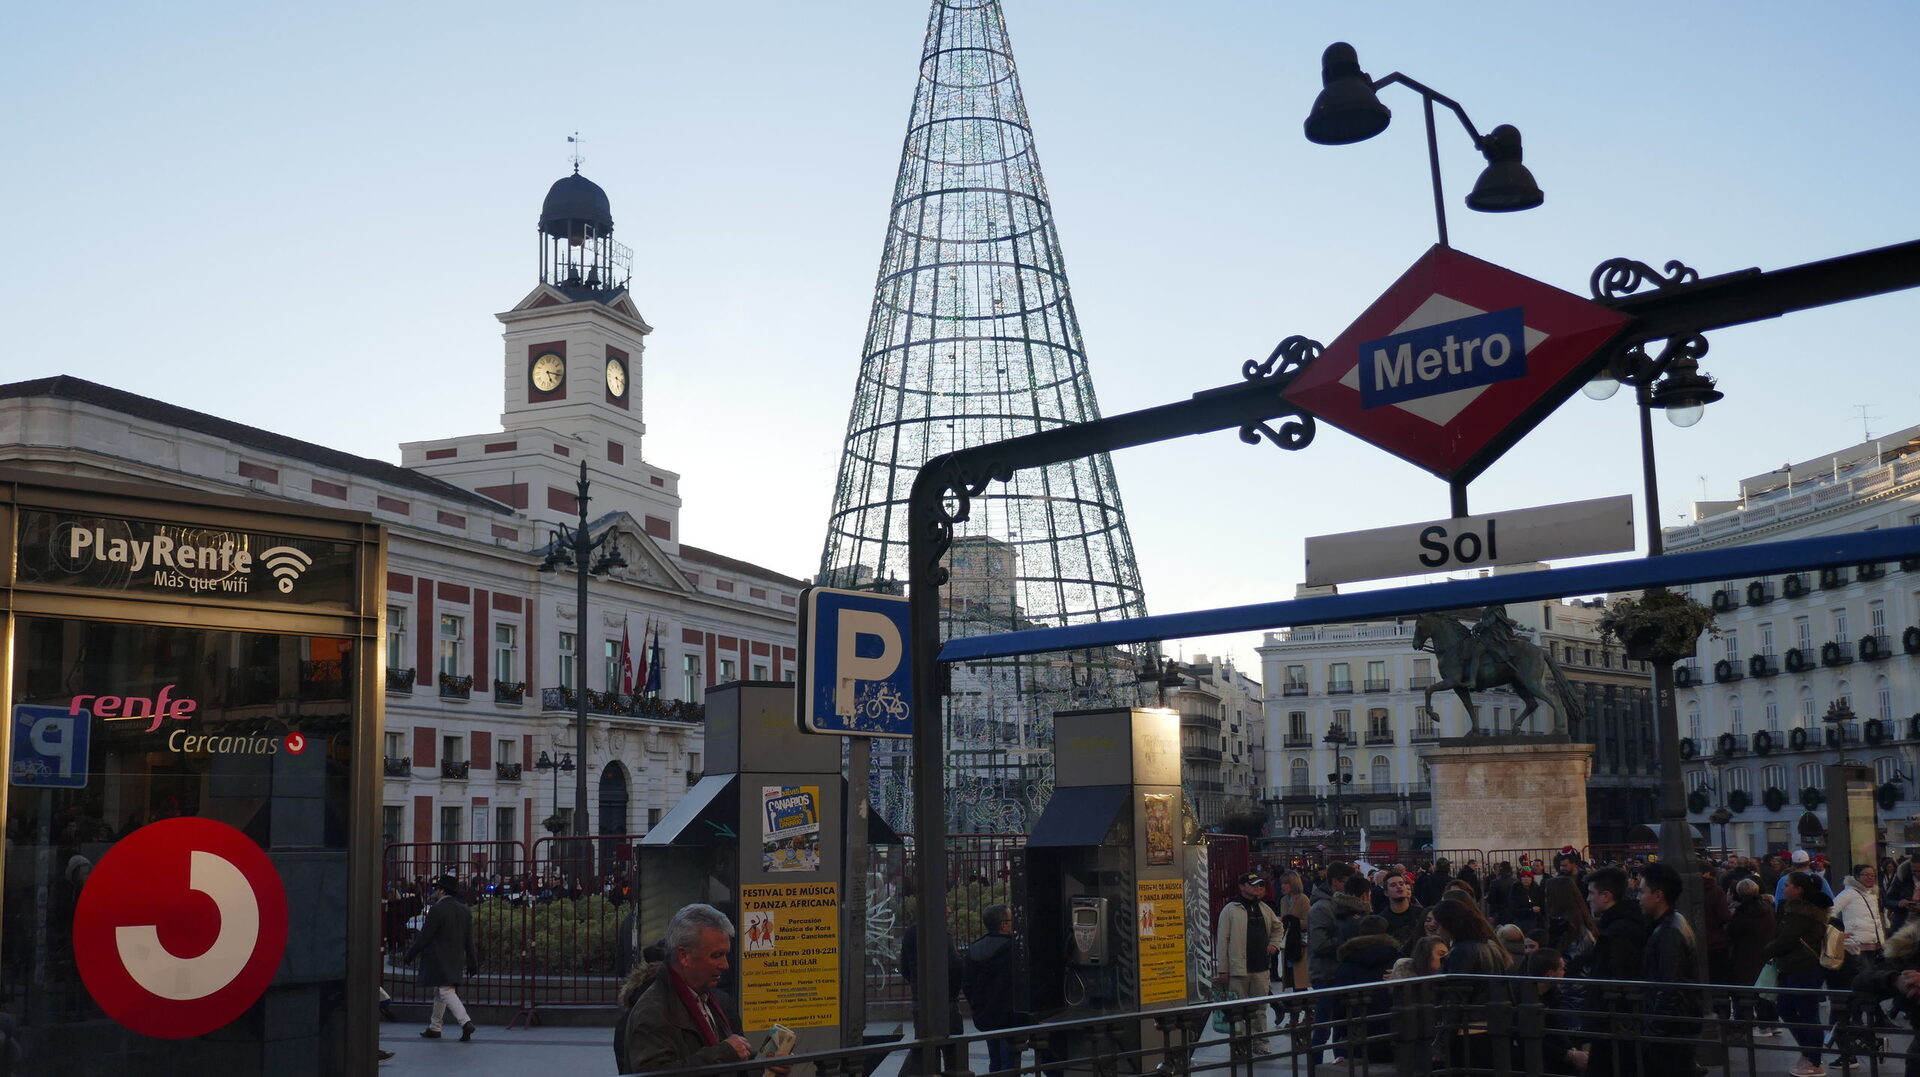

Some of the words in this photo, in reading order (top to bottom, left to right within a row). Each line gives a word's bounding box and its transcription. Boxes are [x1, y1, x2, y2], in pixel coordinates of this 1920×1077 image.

[1373, 332, 1511, 391] Metro
[70, 527, 252, 574] PlayRenfe
[1418, 519, 1498, 568] Sol
[153, 571, 184, 588] Más
[189, 577, 217, 593] que
[222, 576, 248, 593] wifi
[835, 608, 903, 716] P
[69, 684, 197, 732] renfe
[168, 729, 280, 755] Cercanías
[743, 888, 783, 897] FESTIVAL
[786, 888, 797, 896] DE
[800, 885, 835, 896] MÚSICA
[745, 902, 751, 910] Y
[753, 900, 787, 909] DANZA
[790, 899, 837, 908] AFRICANA
[743, 951, 770, 959] Viernes
[779, 949, 800, 957] Enero
